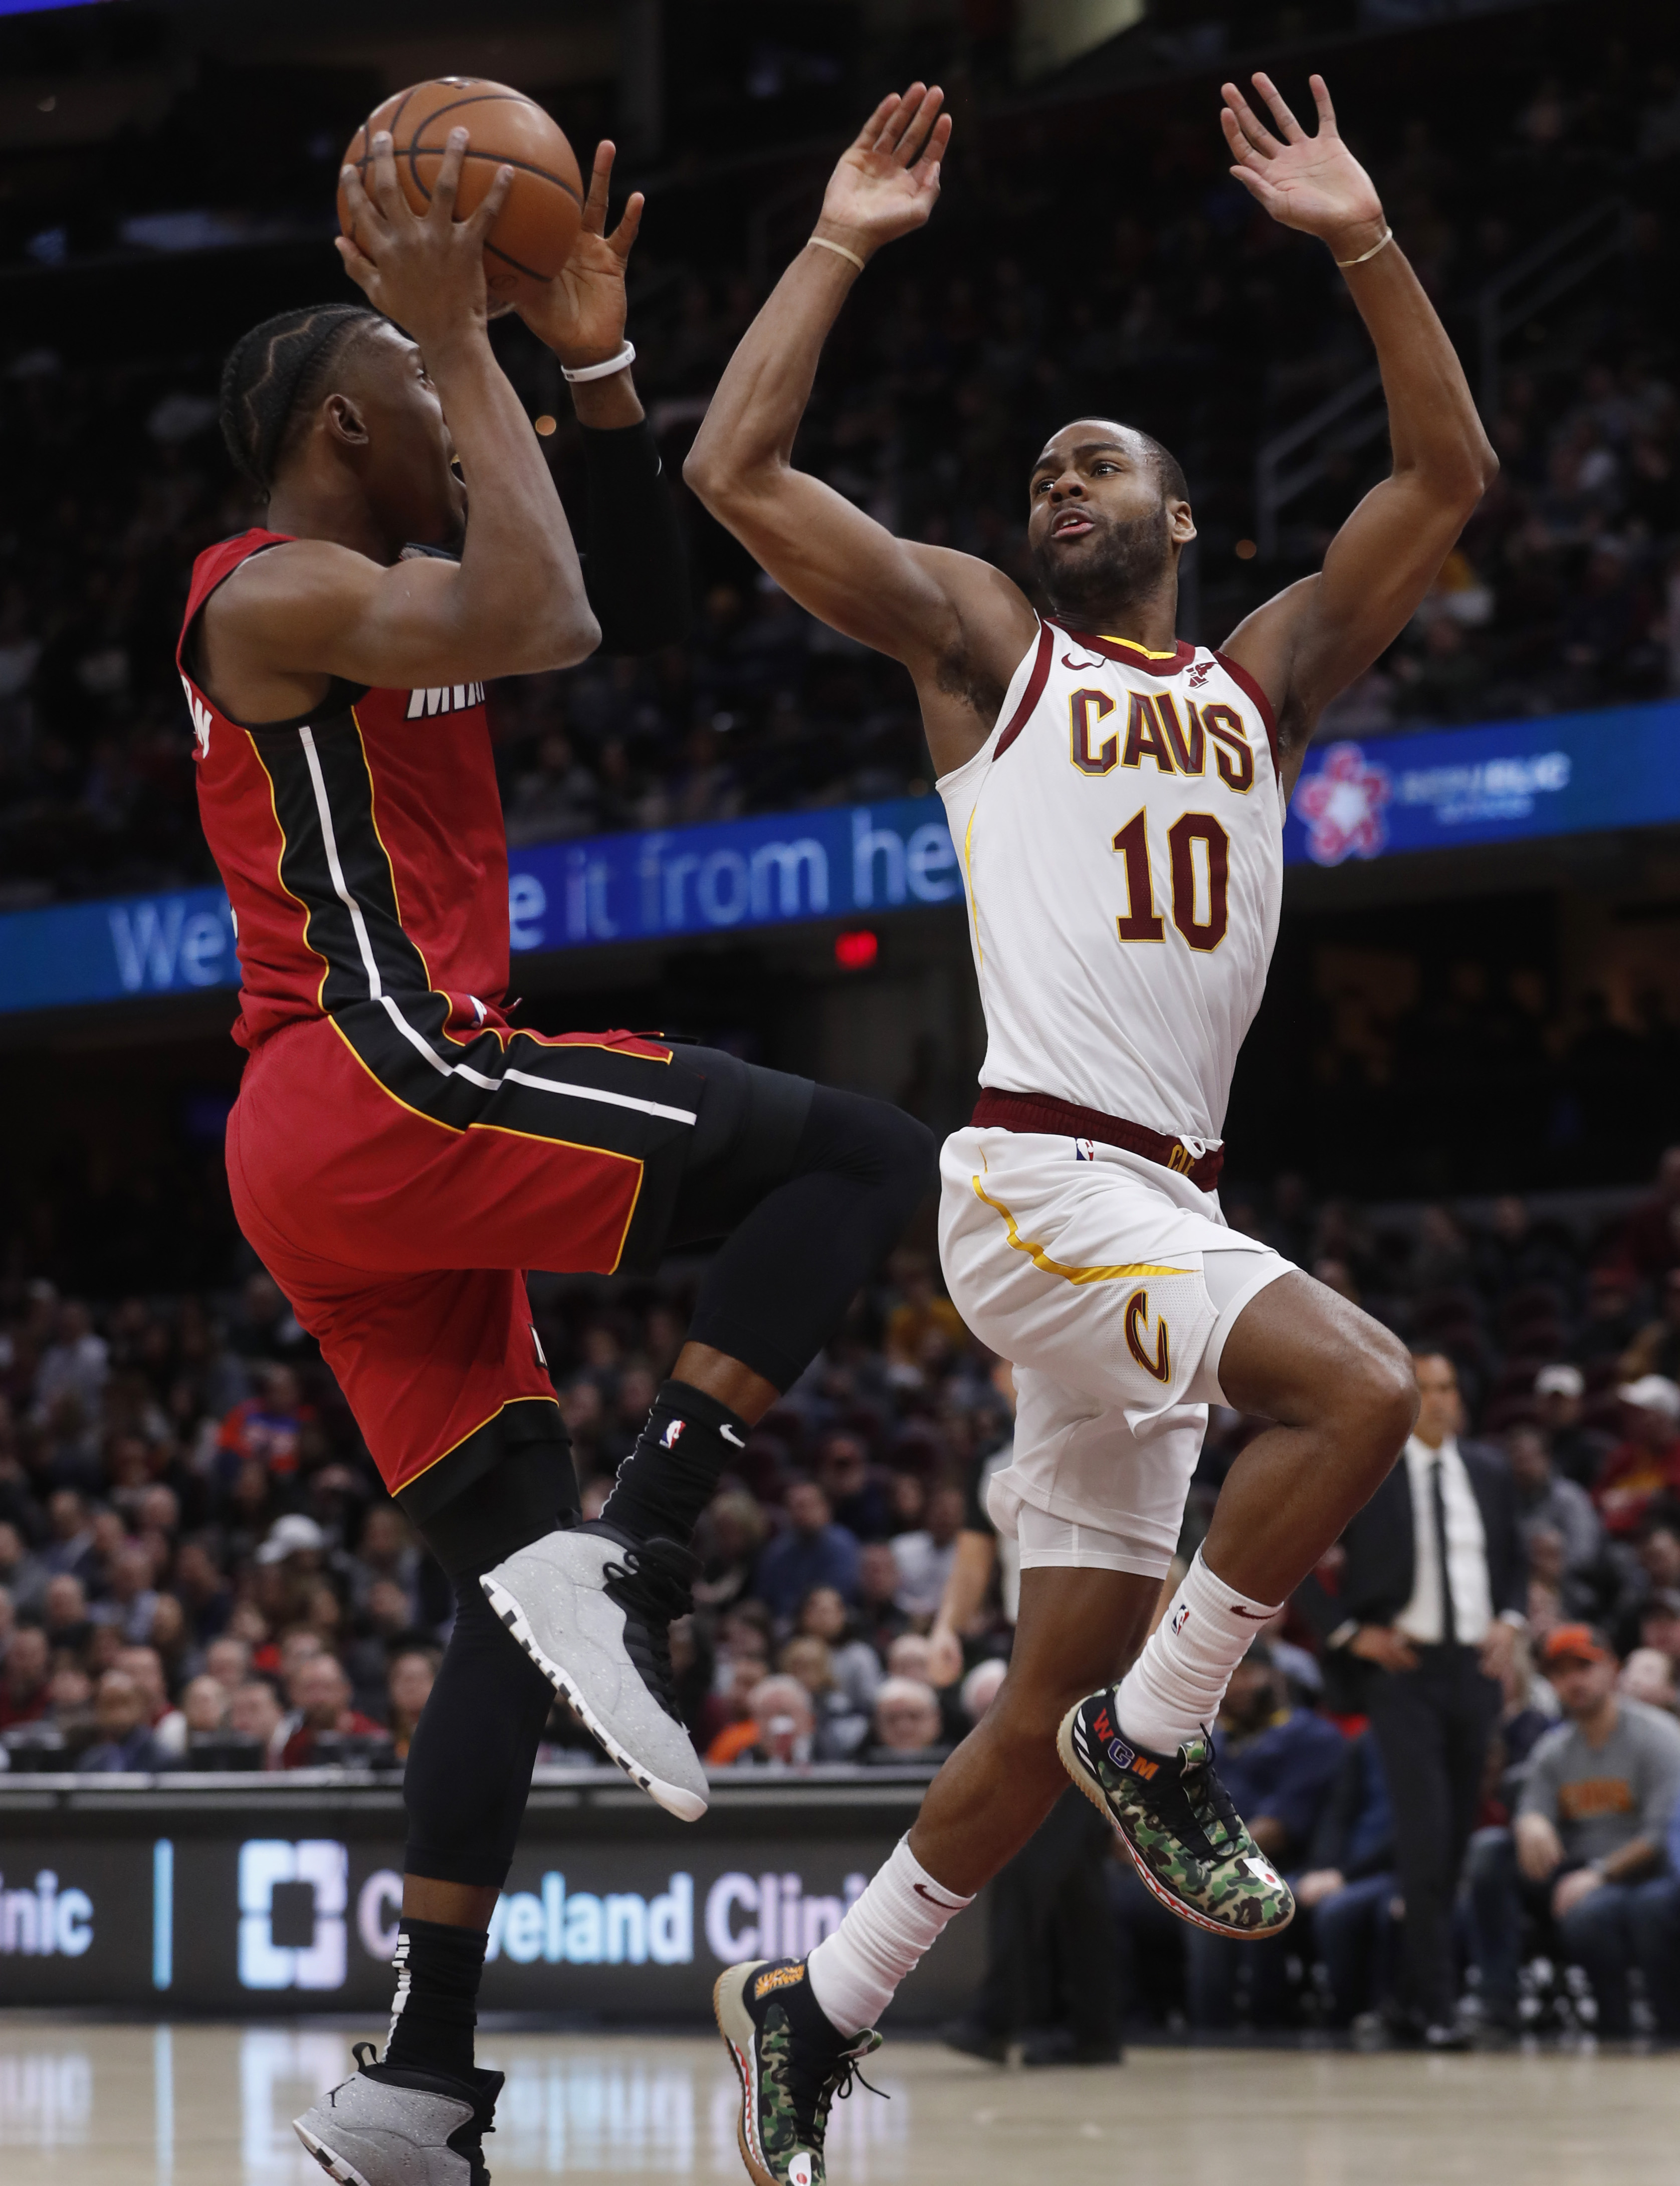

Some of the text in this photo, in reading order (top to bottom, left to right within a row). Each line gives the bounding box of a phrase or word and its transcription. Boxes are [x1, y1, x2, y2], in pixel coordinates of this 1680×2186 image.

[1070, 688, 1254, 795] CAVS
[639, 830, 830, 932] from
[851, 806, 960, 908] he
[1112, 806, 1230, 954] 10
